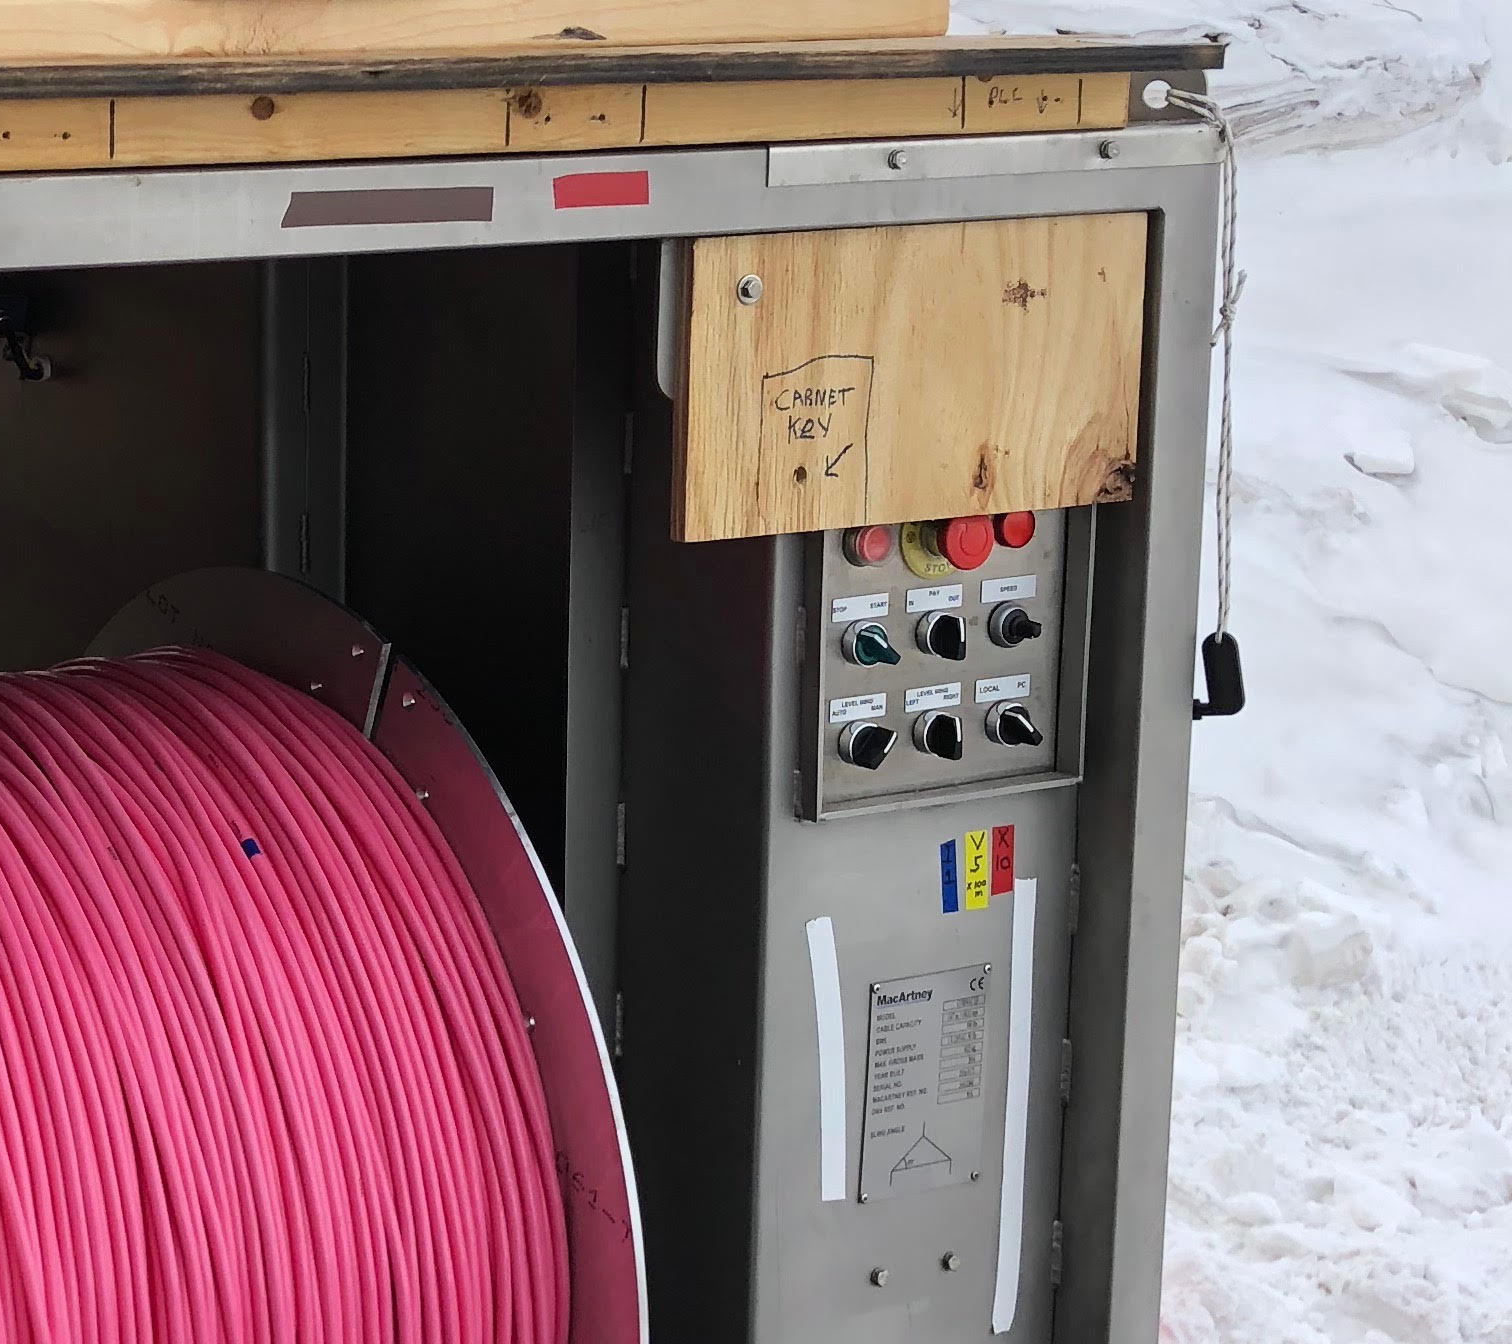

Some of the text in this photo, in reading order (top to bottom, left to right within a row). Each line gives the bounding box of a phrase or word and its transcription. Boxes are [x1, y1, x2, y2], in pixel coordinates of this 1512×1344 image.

[980, 685, 1000, 694] LOCAL
[970, 832, 985, 850] V
[970, 855, 983, 872] 5
[996, 855, 1011, 871] 10
[877, 989, 933, 1006] MacArtney
